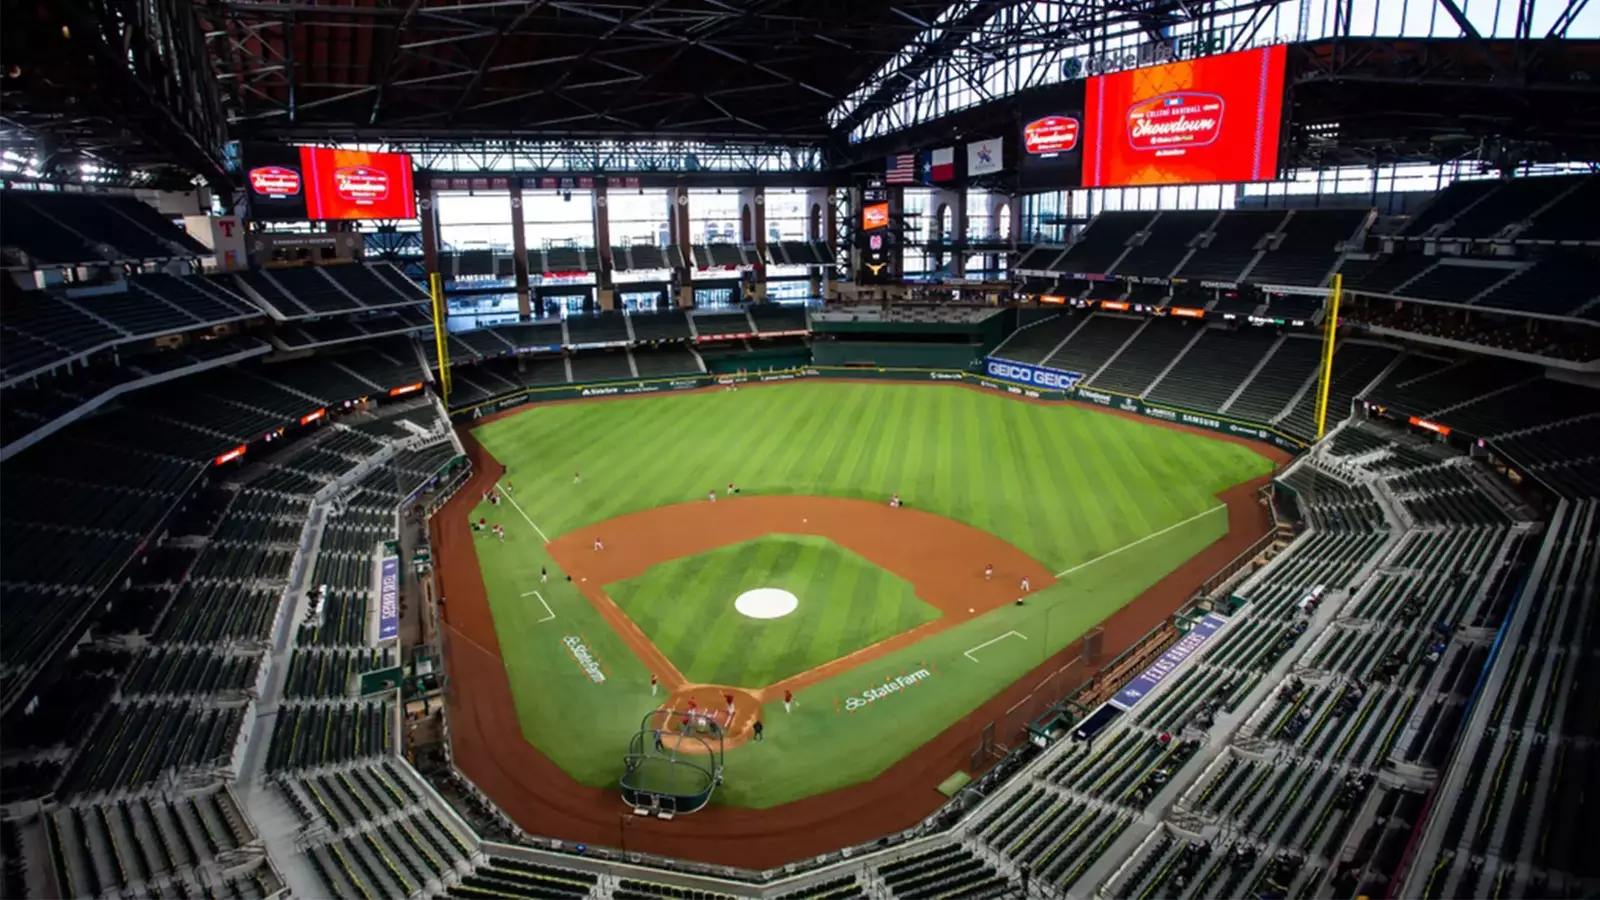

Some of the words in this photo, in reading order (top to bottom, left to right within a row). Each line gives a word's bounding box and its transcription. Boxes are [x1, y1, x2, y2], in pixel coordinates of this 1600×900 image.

[1132, 115, 1215, 137] Showdown
[455, 274, 496, 282] SAMSUNG
[987, 362, 1031, 381] GEICO
[1182, 413, 1220, 428] SAMSUNG
[1140, 658, 1176, 684] TEXAS
[1166, 632, 1206, 661] RANGERS
